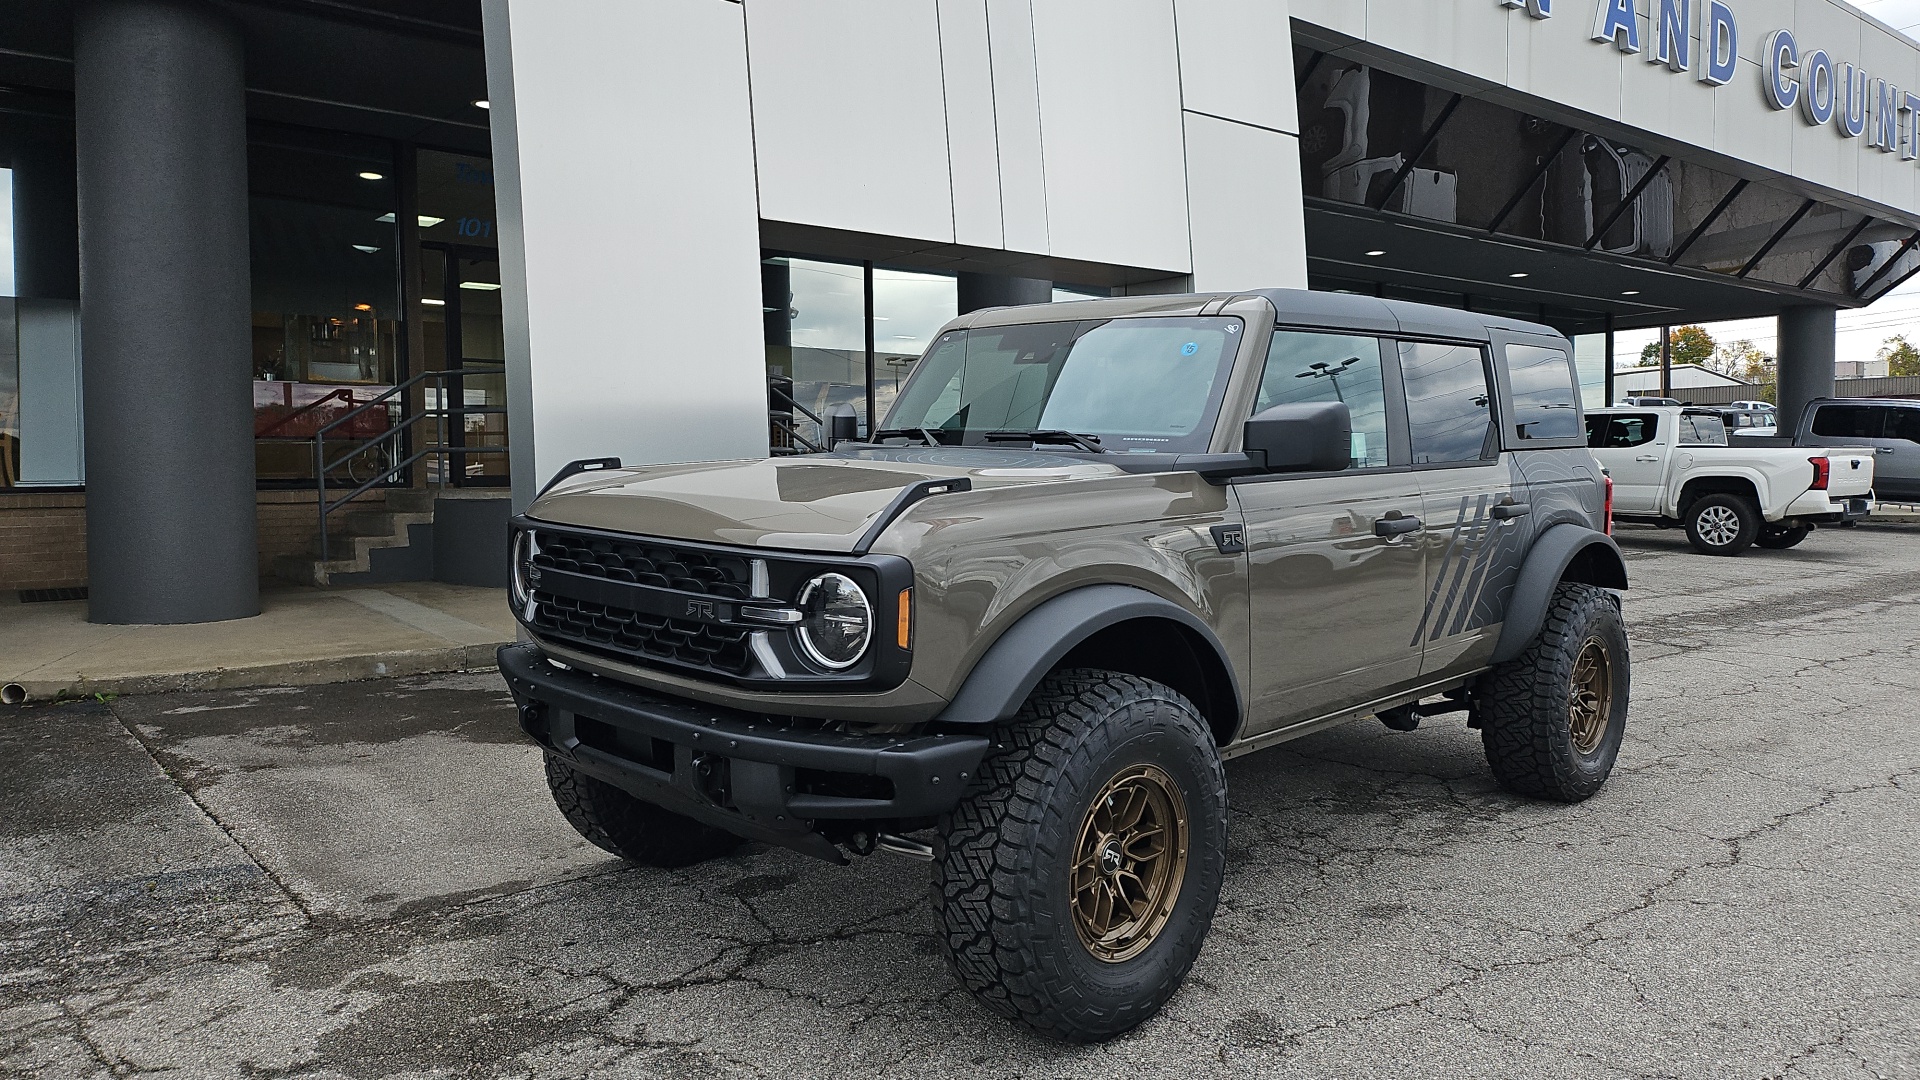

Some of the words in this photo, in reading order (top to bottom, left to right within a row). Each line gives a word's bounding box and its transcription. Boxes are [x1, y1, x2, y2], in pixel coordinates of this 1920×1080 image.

[1591, 0, 1738, 86] AND
[456, 217, 491, 237] 101
[1222, 531, 1244, 546] RTR
[686, 600, 715, 619] RTR
[1103, 849, 1120, 866] RTR
